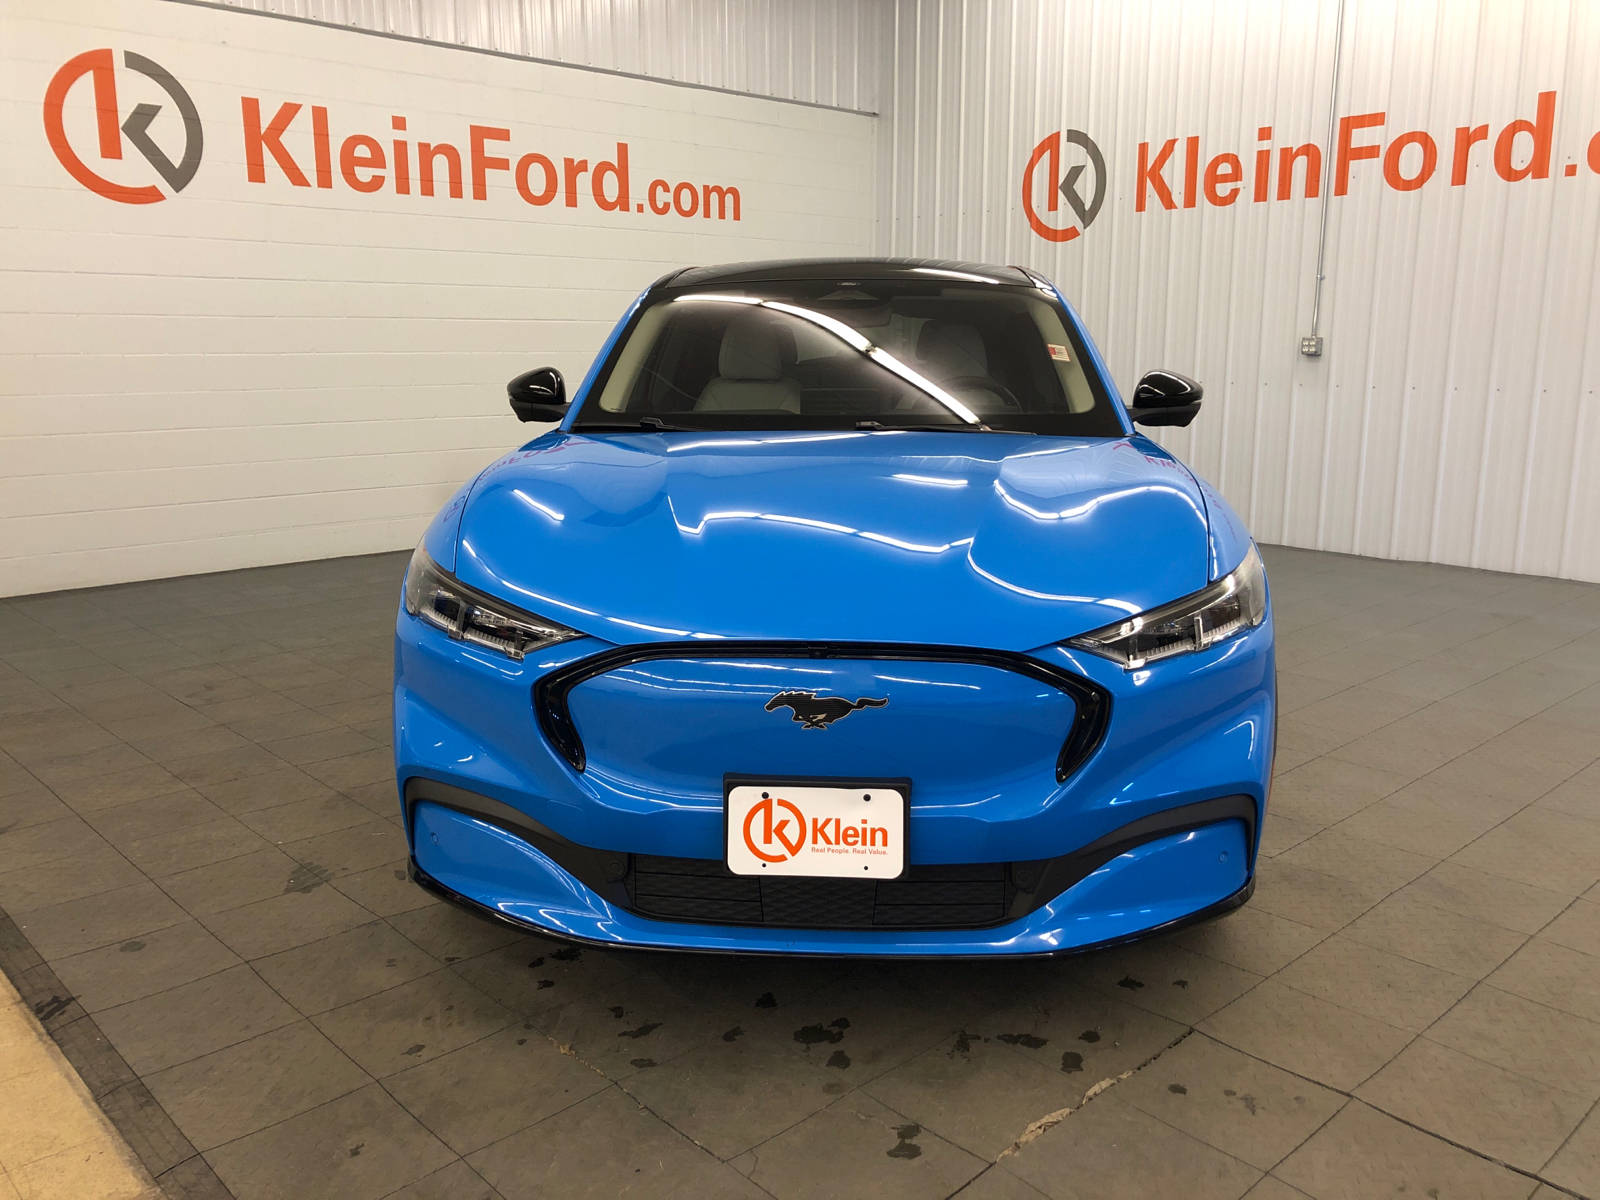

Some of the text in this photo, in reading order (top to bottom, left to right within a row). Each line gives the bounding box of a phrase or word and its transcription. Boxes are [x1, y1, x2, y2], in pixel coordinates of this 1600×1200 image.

[241, 97, 741, 222] KleinFord.com
[811, 817, 888, 847] Klein
[827, 847, 851, 855] People.
